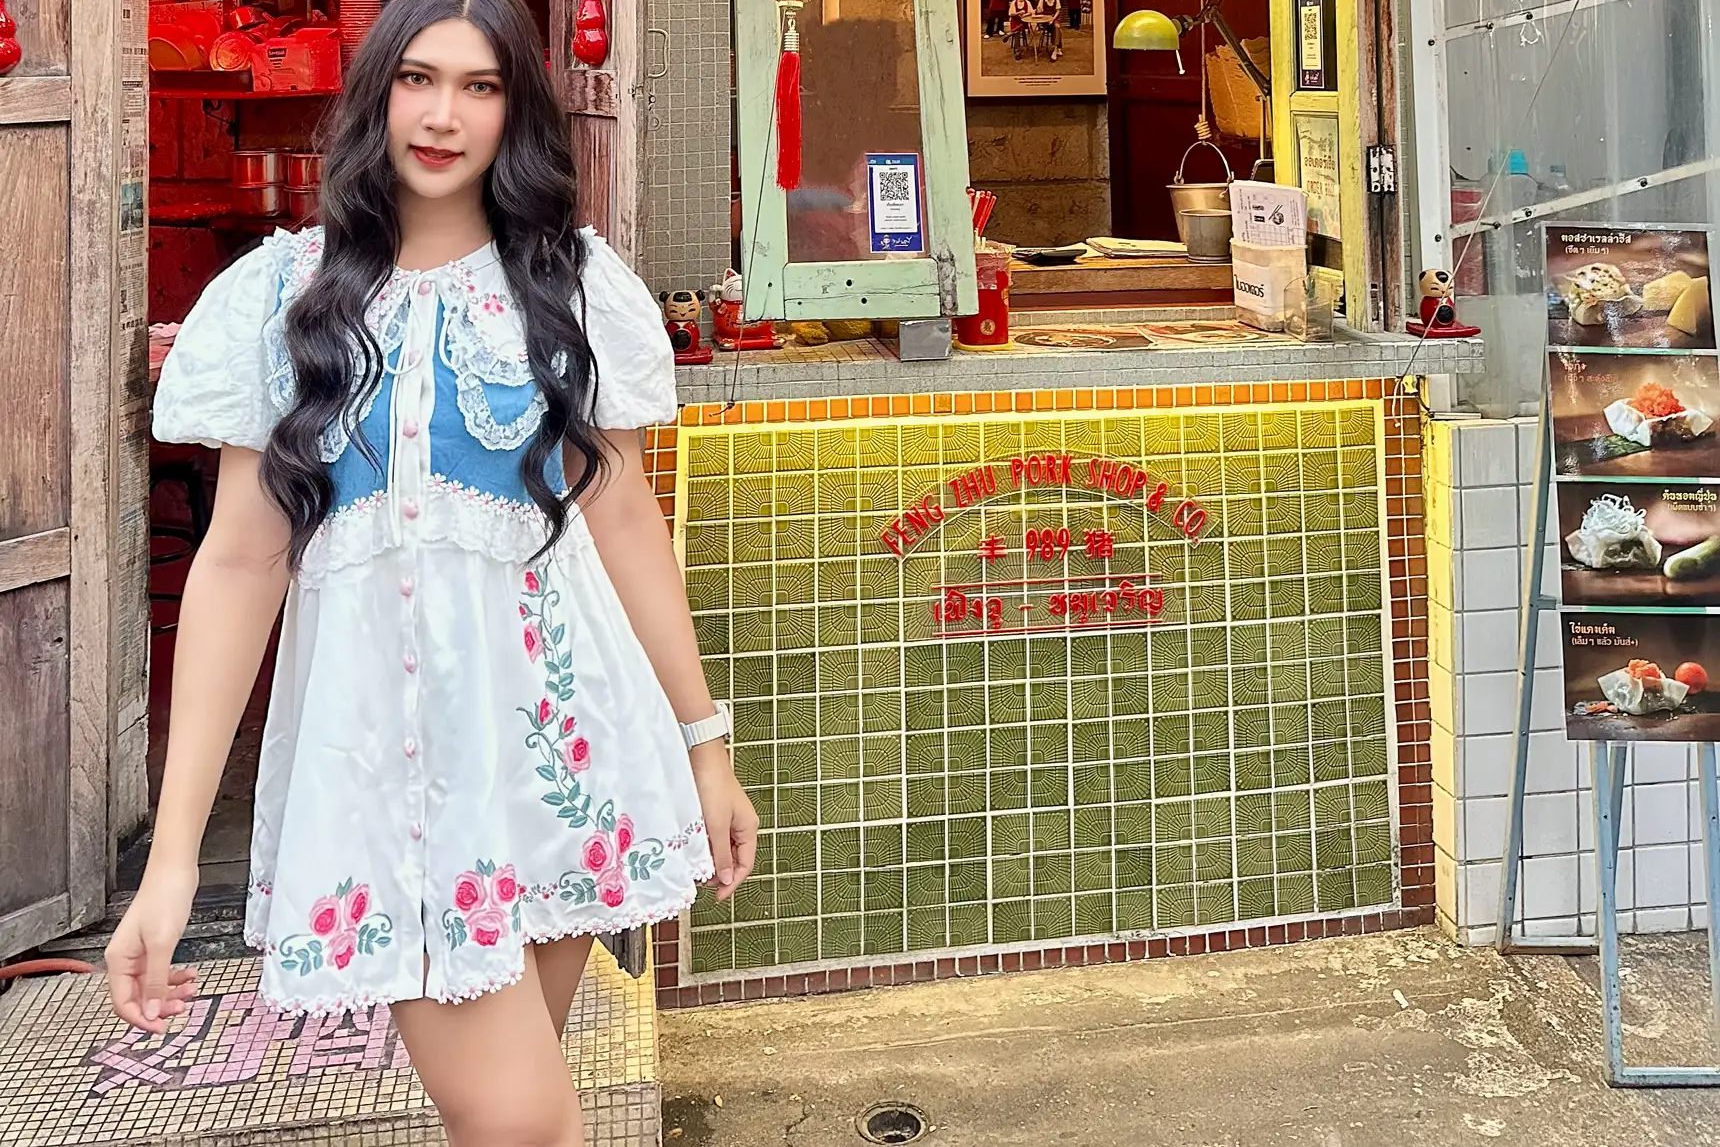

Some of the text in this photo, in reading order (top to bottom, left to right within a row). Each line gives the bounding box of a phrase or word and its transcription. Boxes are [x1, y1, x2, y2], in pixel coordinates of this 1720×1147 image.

[880, 495, 945, 557] FENG
[947, 464, 998, 508] ZHU
[1010, 453, 1073, 489] PORK
[1086, 458, 1148, 500] SHOP
[1145, 481, 1168, 513] &
[1025, 527, 1071, 562] 989
